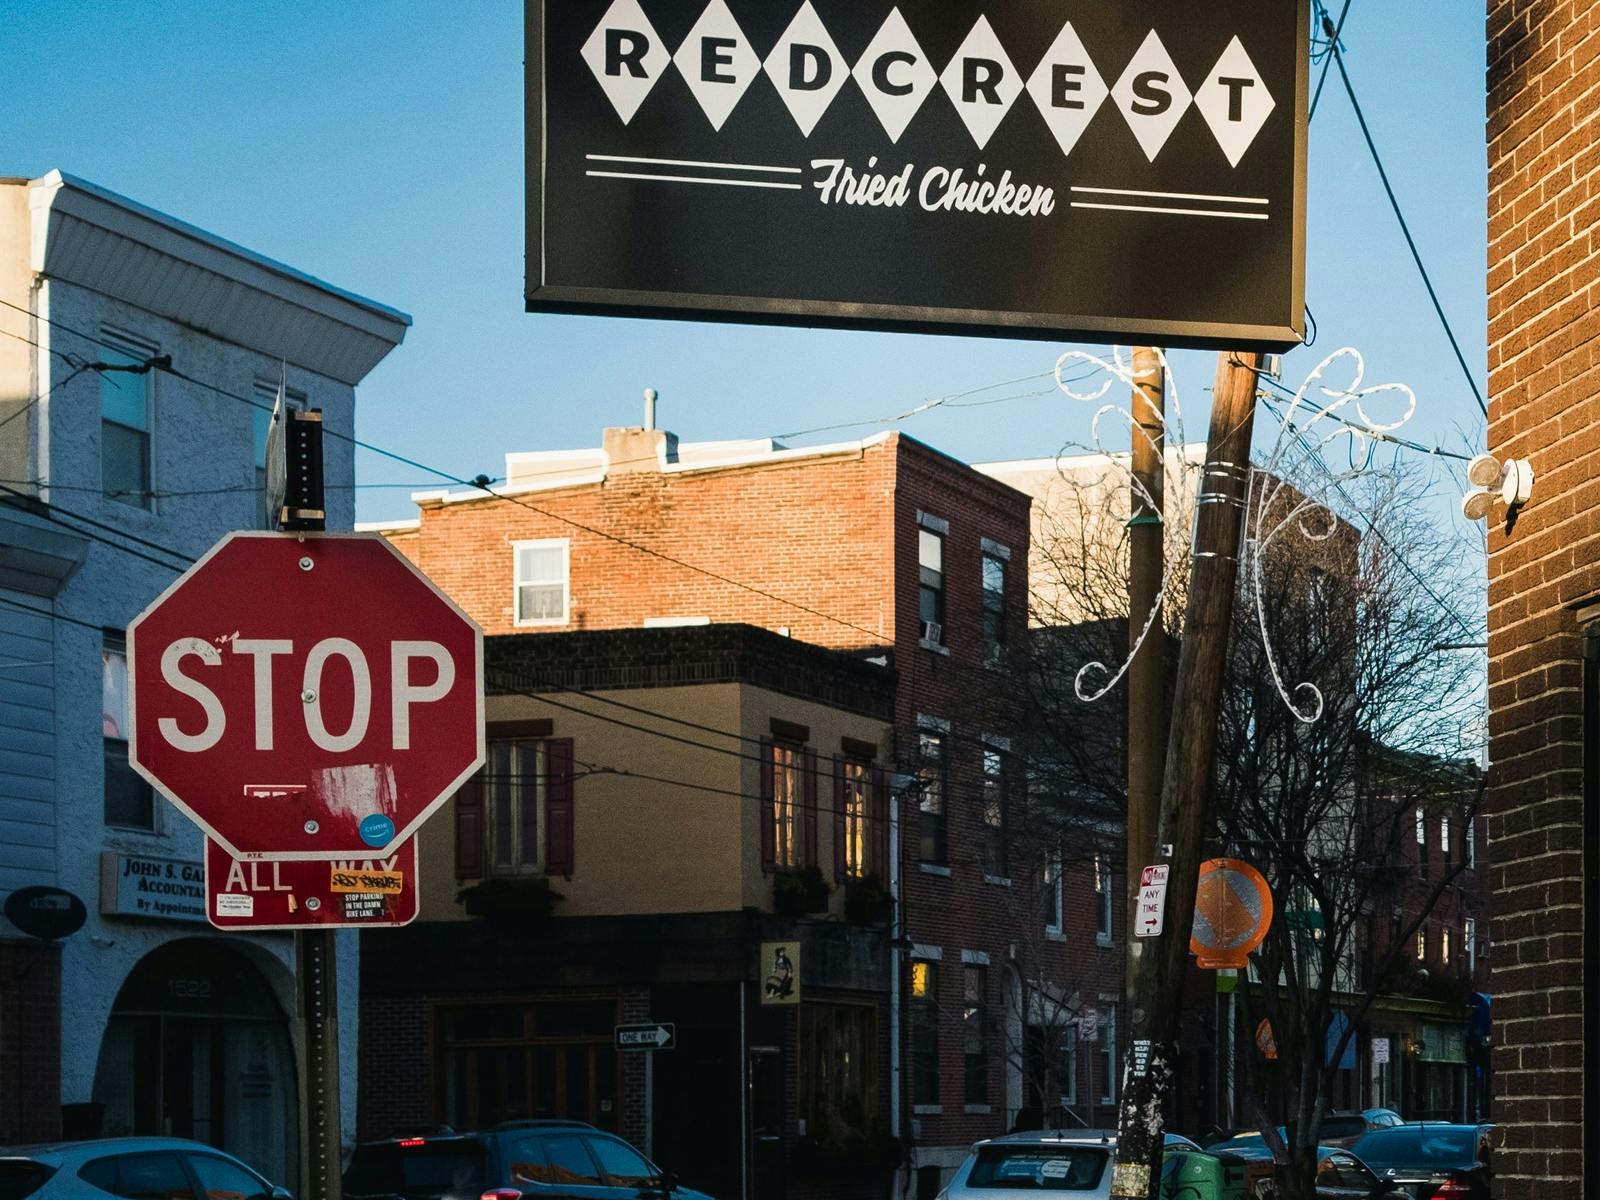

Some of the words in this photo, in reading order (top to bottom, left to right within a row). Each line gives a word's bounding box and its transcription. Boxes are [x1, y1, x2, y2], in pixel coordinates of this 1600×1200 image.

[604, 29, 1255, 122] REDCREST
[811, 156, 914, 207] Fried
[919, 163, 1055, 216] Chicken
[158, 637, 455, 752] STOP
[123, 859, 161, 877] JOHN
[165, 863, 177, 879] S.
[225, 858, 293, 892] ALL
[1144, 890, 1160, 899] ANY
[137, 898, 150, 912] By
[1143, 904, 1158, 913] TIME
[622, 1032, 638, 1041] ONE
[641, 1031, 656, 1040] WAY
